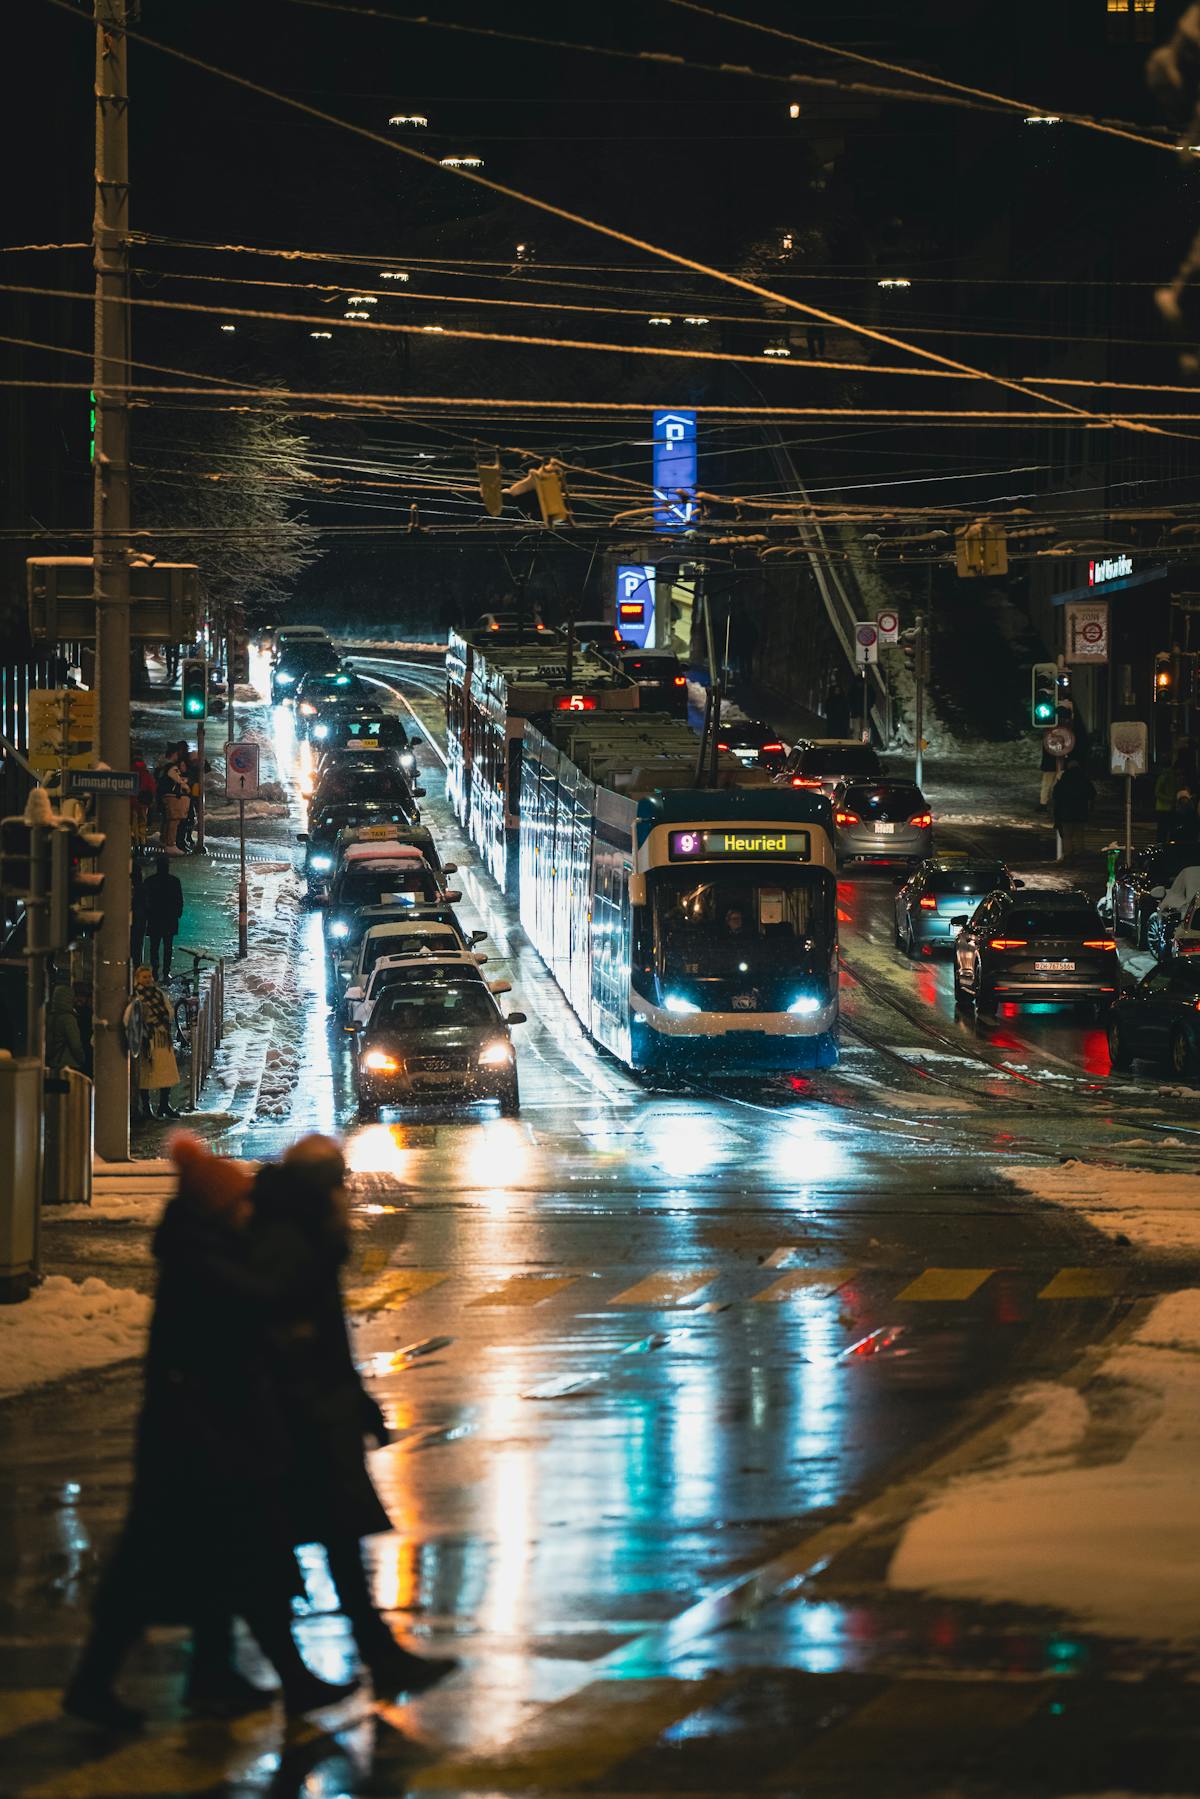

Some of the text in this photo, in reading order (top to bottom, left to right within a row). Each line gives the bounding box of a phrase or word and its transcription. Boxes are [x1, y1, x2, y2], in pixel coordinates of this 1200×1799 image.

[666, 424, 684, 450] P
[625, 577, 639, 597] P
[570, 694, 584, 710] 5
[72, 775, 134, 791] Limmatquai
[680, 834, 786, 852] 9 Heuried
